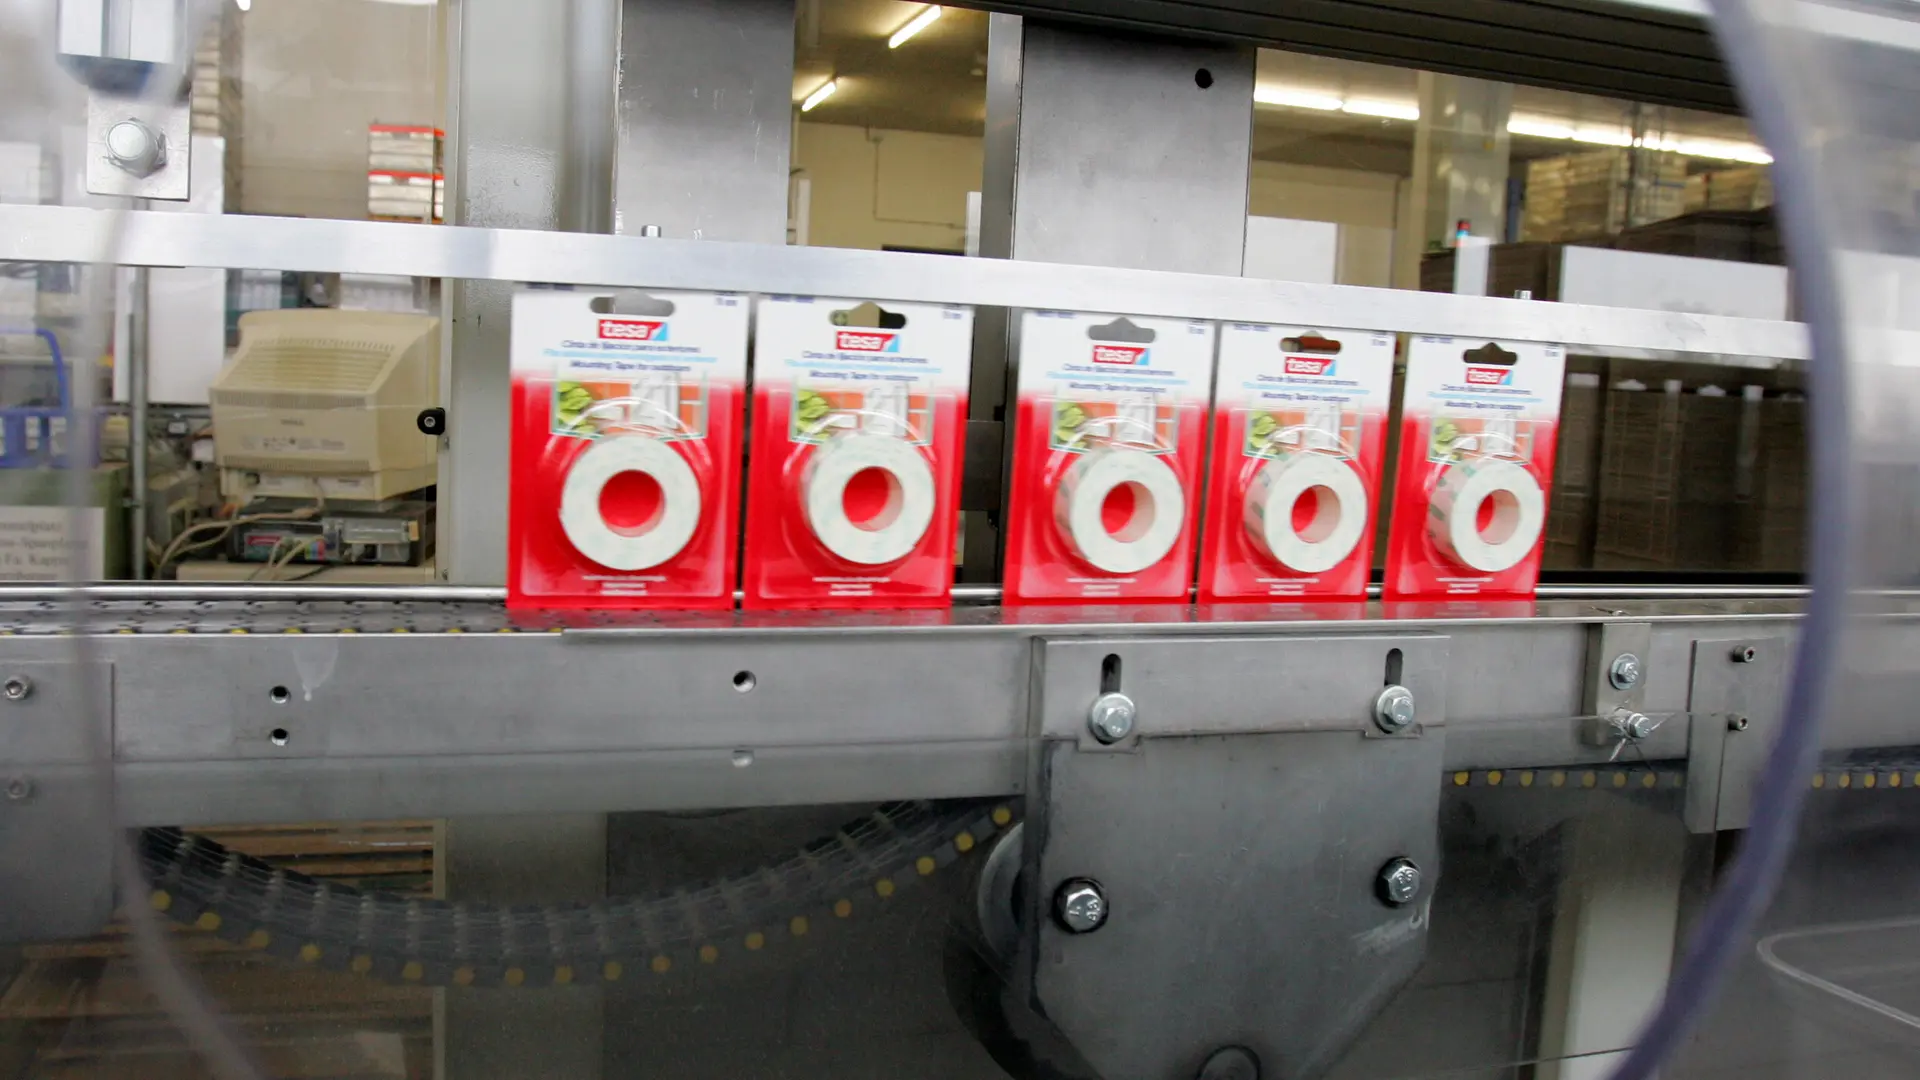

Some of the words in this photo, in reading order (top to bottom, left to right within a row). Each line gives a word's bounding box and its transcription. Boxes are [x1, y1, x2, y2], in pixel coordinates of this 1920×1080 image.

[600, 321, 649, 338] tesa
[838, 332, 883, 349] tesa
[1095, 347, 1135, 362] tesa
[1286, 359, 1322, 373] tesa
[1468, 369, 1501, 383] tesa
